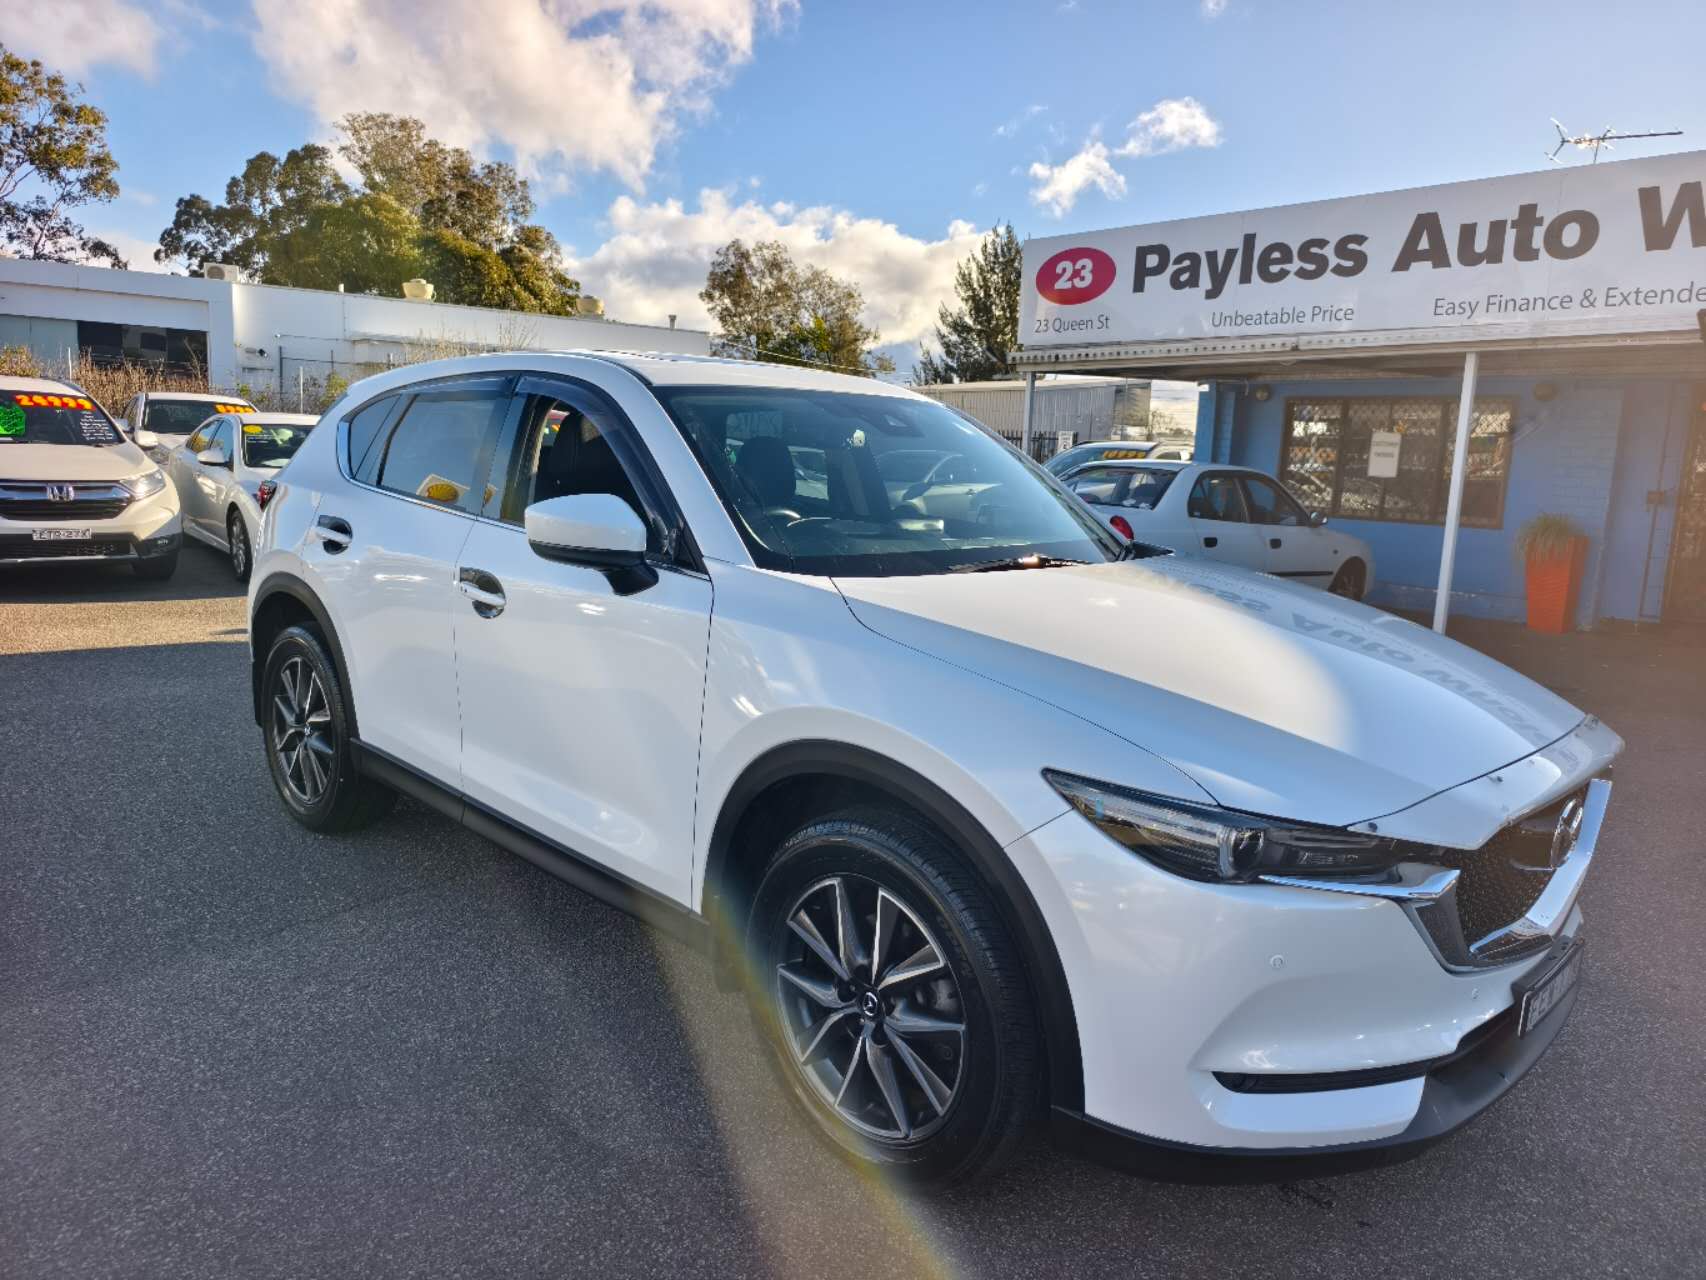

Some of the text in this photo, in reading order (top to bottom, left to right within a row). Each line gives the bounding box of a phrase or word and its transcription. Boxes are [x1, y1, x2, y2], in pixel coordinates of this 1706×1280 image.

[1132, 232, 1369, 300] Payless
[1391, 203, 1600, 272] Auto
[1054, 258, 1094, 290] 23
[1211, 304, 1355, 328] Unbeatable Price
[1433, 281, 1706, 319] Easy Finance & Extende
[1034, 314, 1111, 333] 23 Queen St
